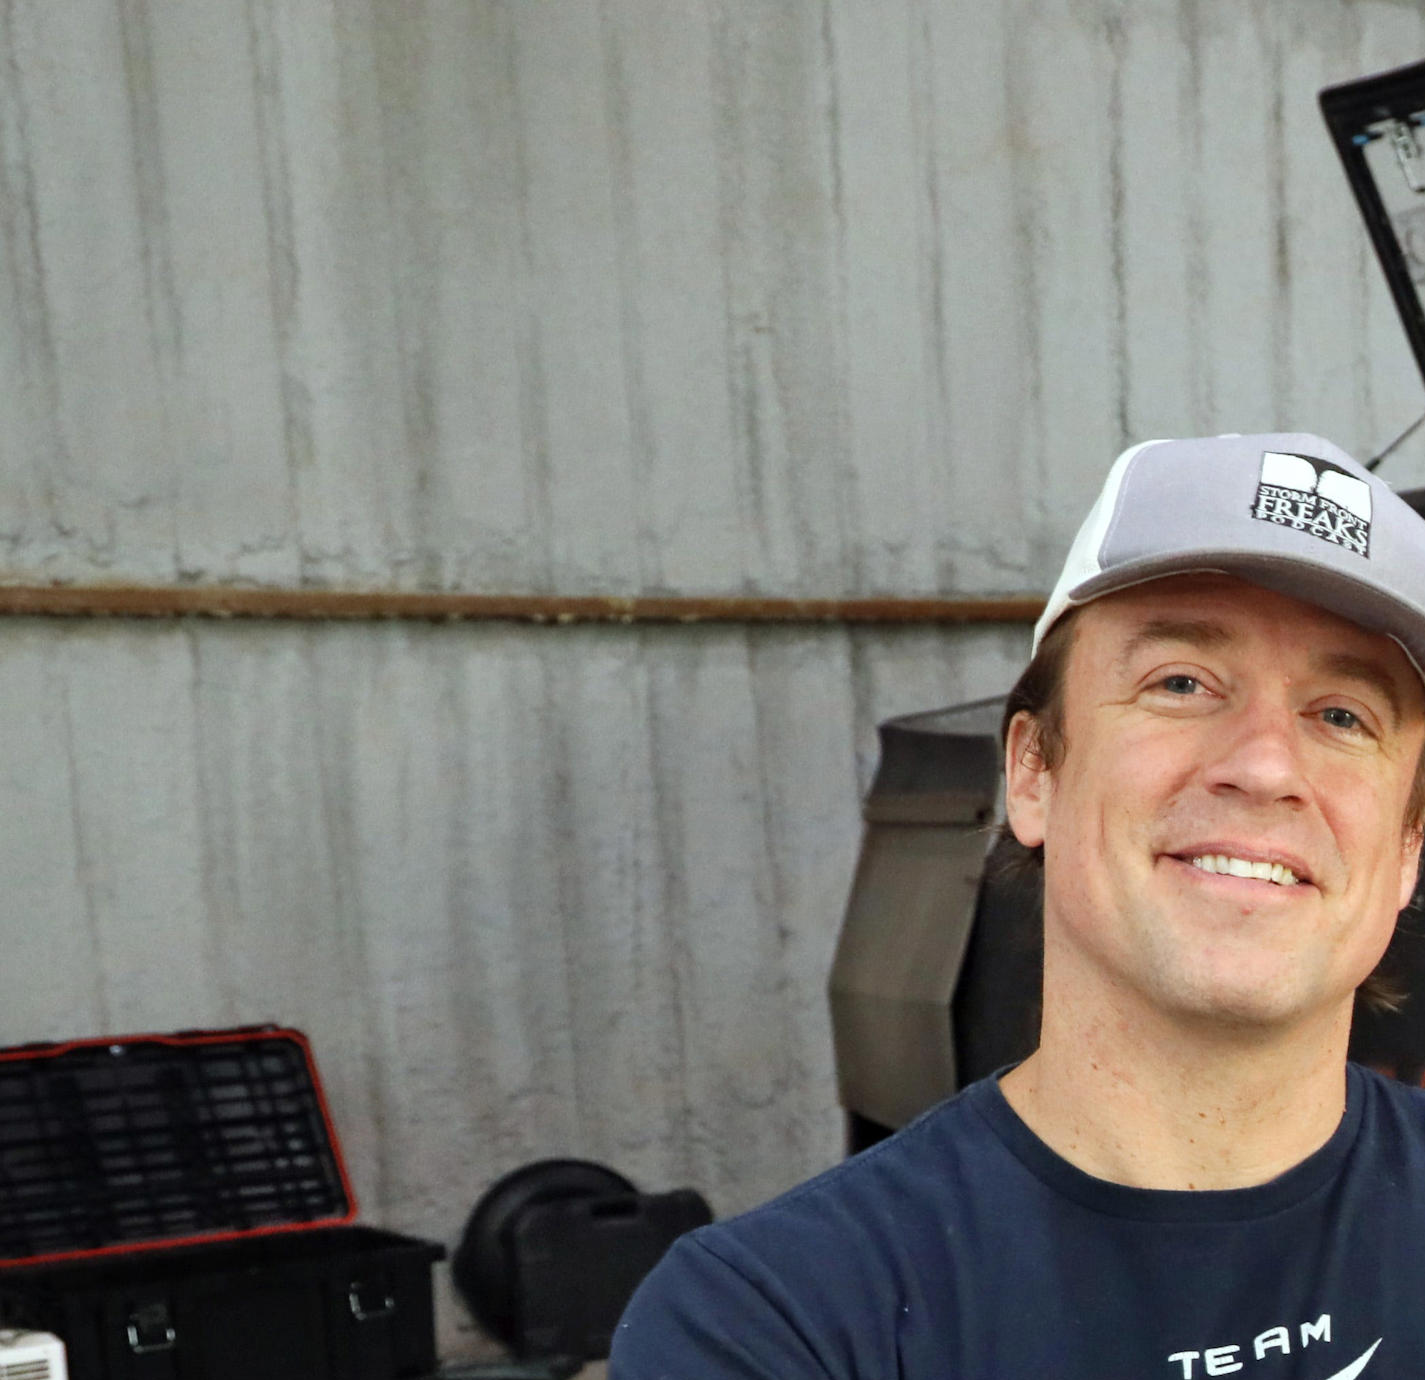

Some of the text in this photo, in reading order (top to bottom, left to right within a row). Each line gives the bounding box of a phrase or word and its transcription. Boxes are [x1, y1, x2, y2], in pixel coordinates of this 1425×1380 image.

[1255, 508, 1368, 556] PODCAST
[1257, 494, 1368, 548] FREAKS
[1259, 485, 1368, 531] STORM FRONT
[1167, 1313, 1332, 1380] TEAM
